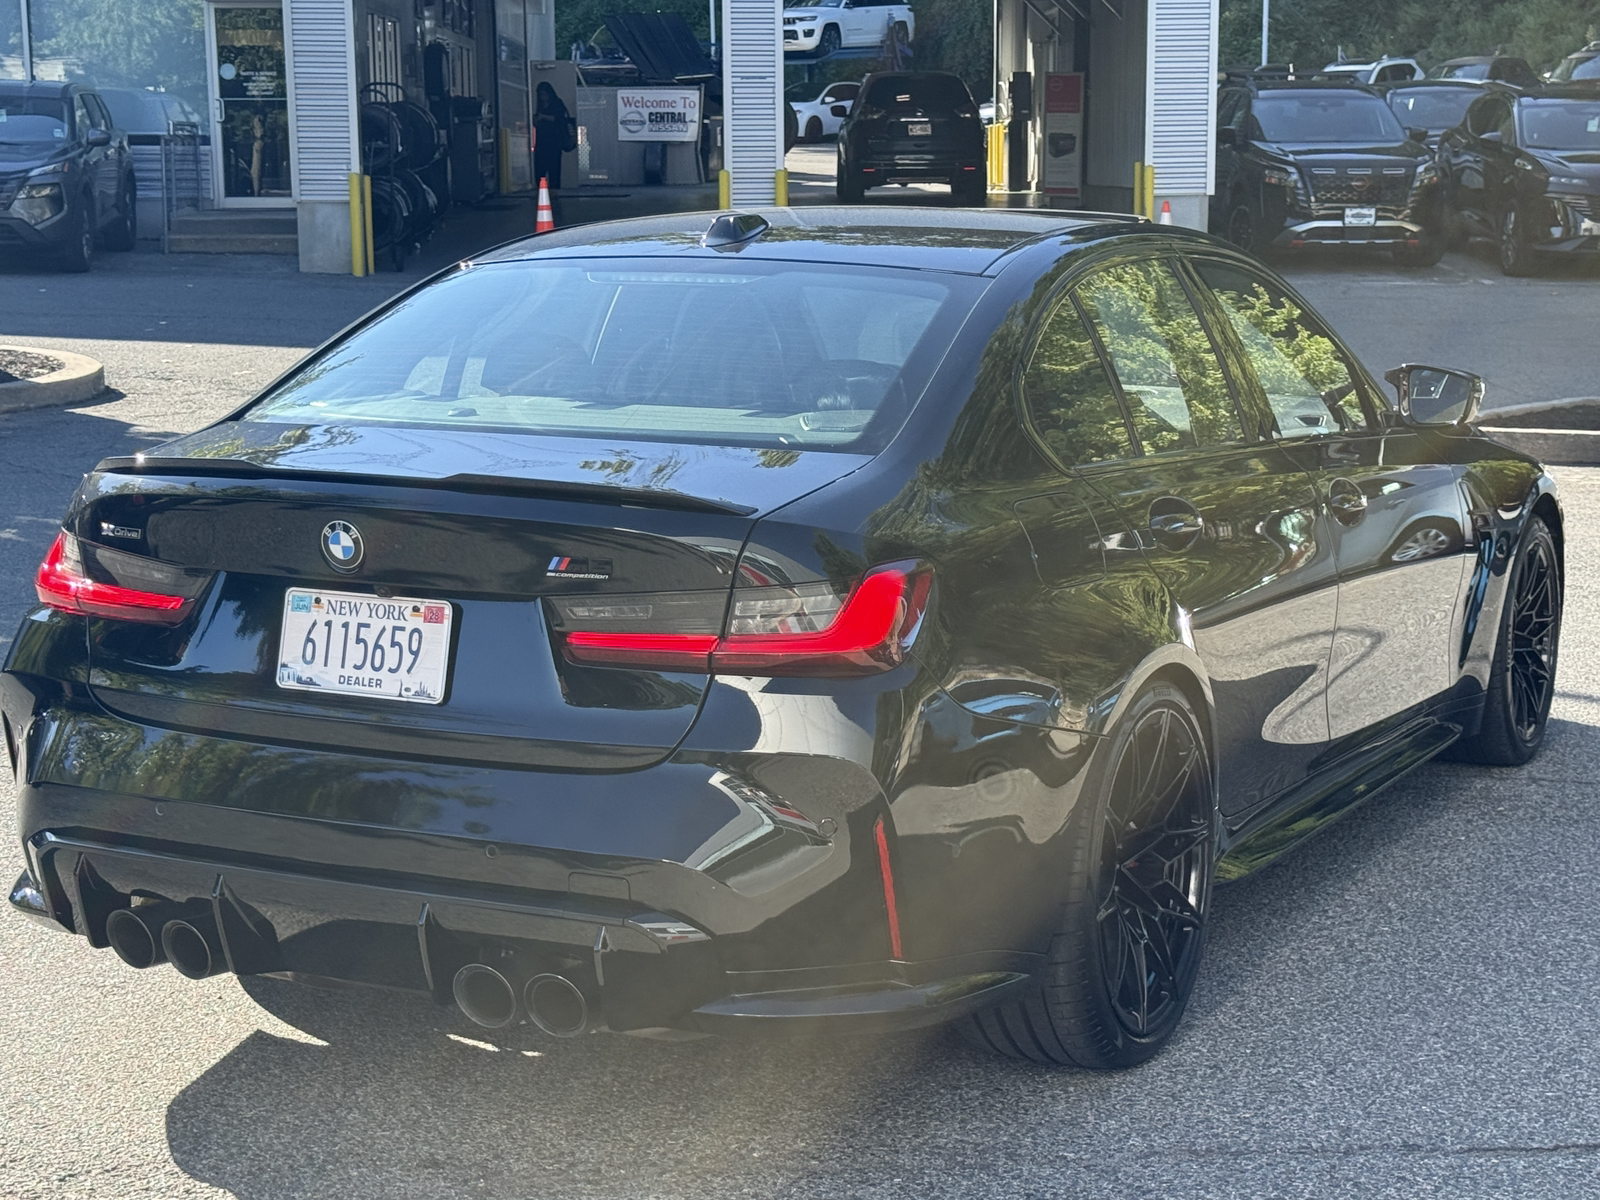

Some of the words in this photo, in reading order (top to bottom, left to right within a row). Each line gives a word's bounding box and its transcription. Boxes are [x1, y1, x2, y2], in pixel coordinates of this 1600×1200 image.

[620, 96, 677, 109] Welcome
[680, 96, 697, 109] To
[648, 112, 688, 123] CENTRAL
[647, 123, 688, 133] NISSAN
[555, 572, 609, 580] competition
[294, 602, 309, 611] JUN
[325, 599, 362, 617] NEW
[366, 602, 409, 621] YORK
[429, 610, 440, 620] 28
[301, 618, 424, 675] 6115659
[338, 674, 383, 689] DEALER
